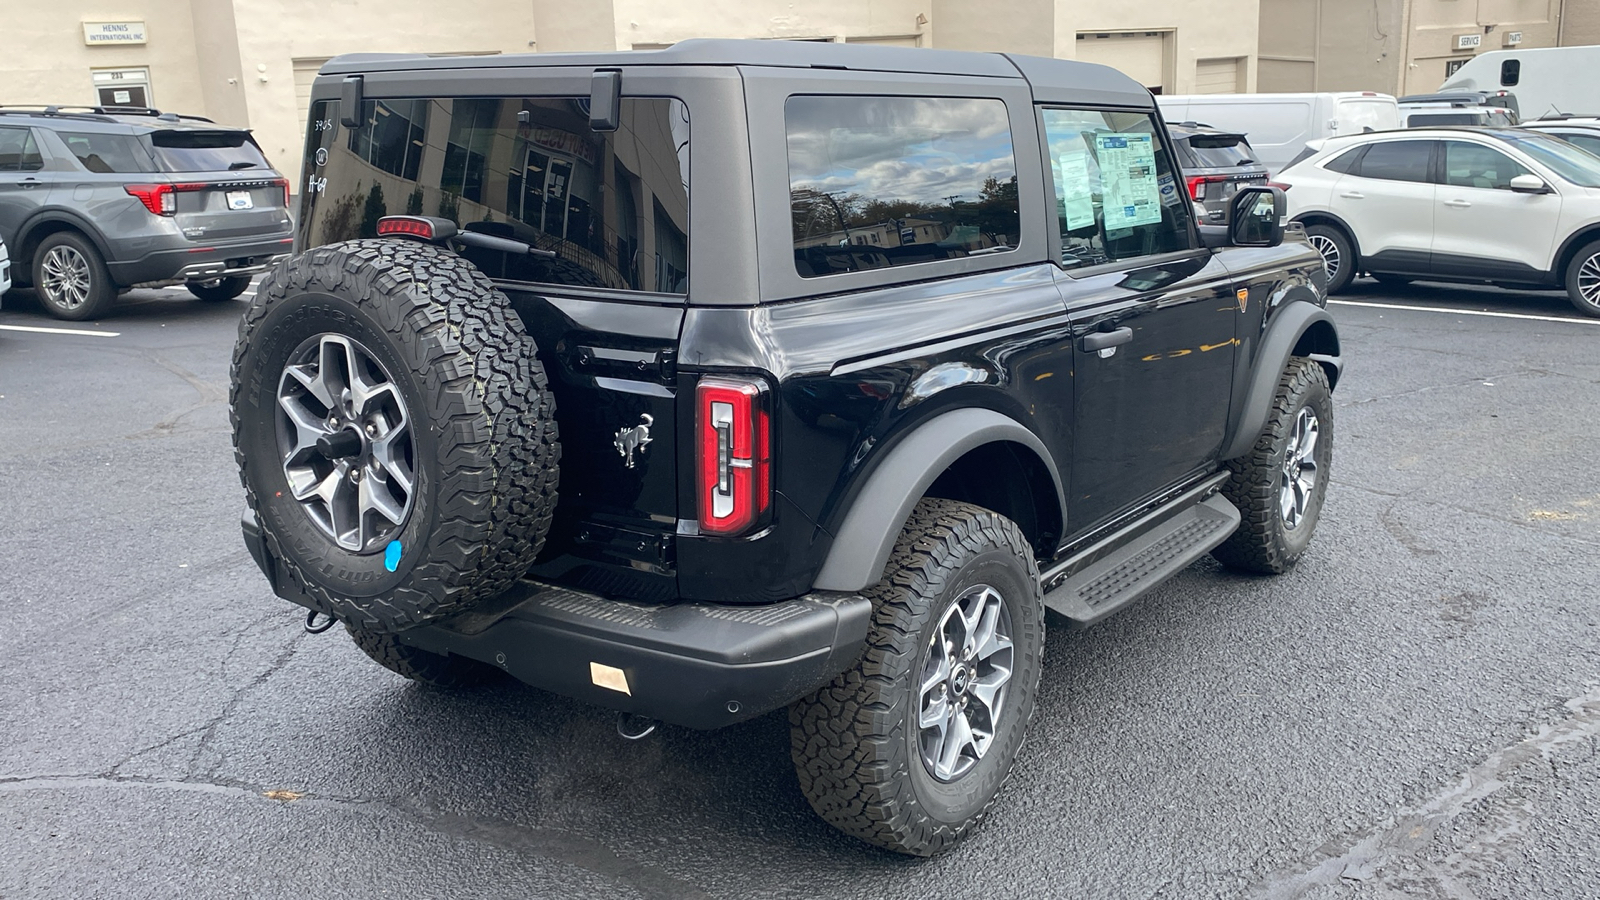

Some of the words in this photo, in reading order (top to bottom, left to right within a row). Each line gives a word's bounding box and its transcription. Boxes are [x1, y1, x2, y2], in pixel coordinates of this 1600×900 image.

[102, 24, 128, 32] HENNIS
[90, 33, 133, 41] INTERNATIONAL
[1461, 36, 1479, 46] SERVICE
[1510, 34, 1521, 42] PARTS
